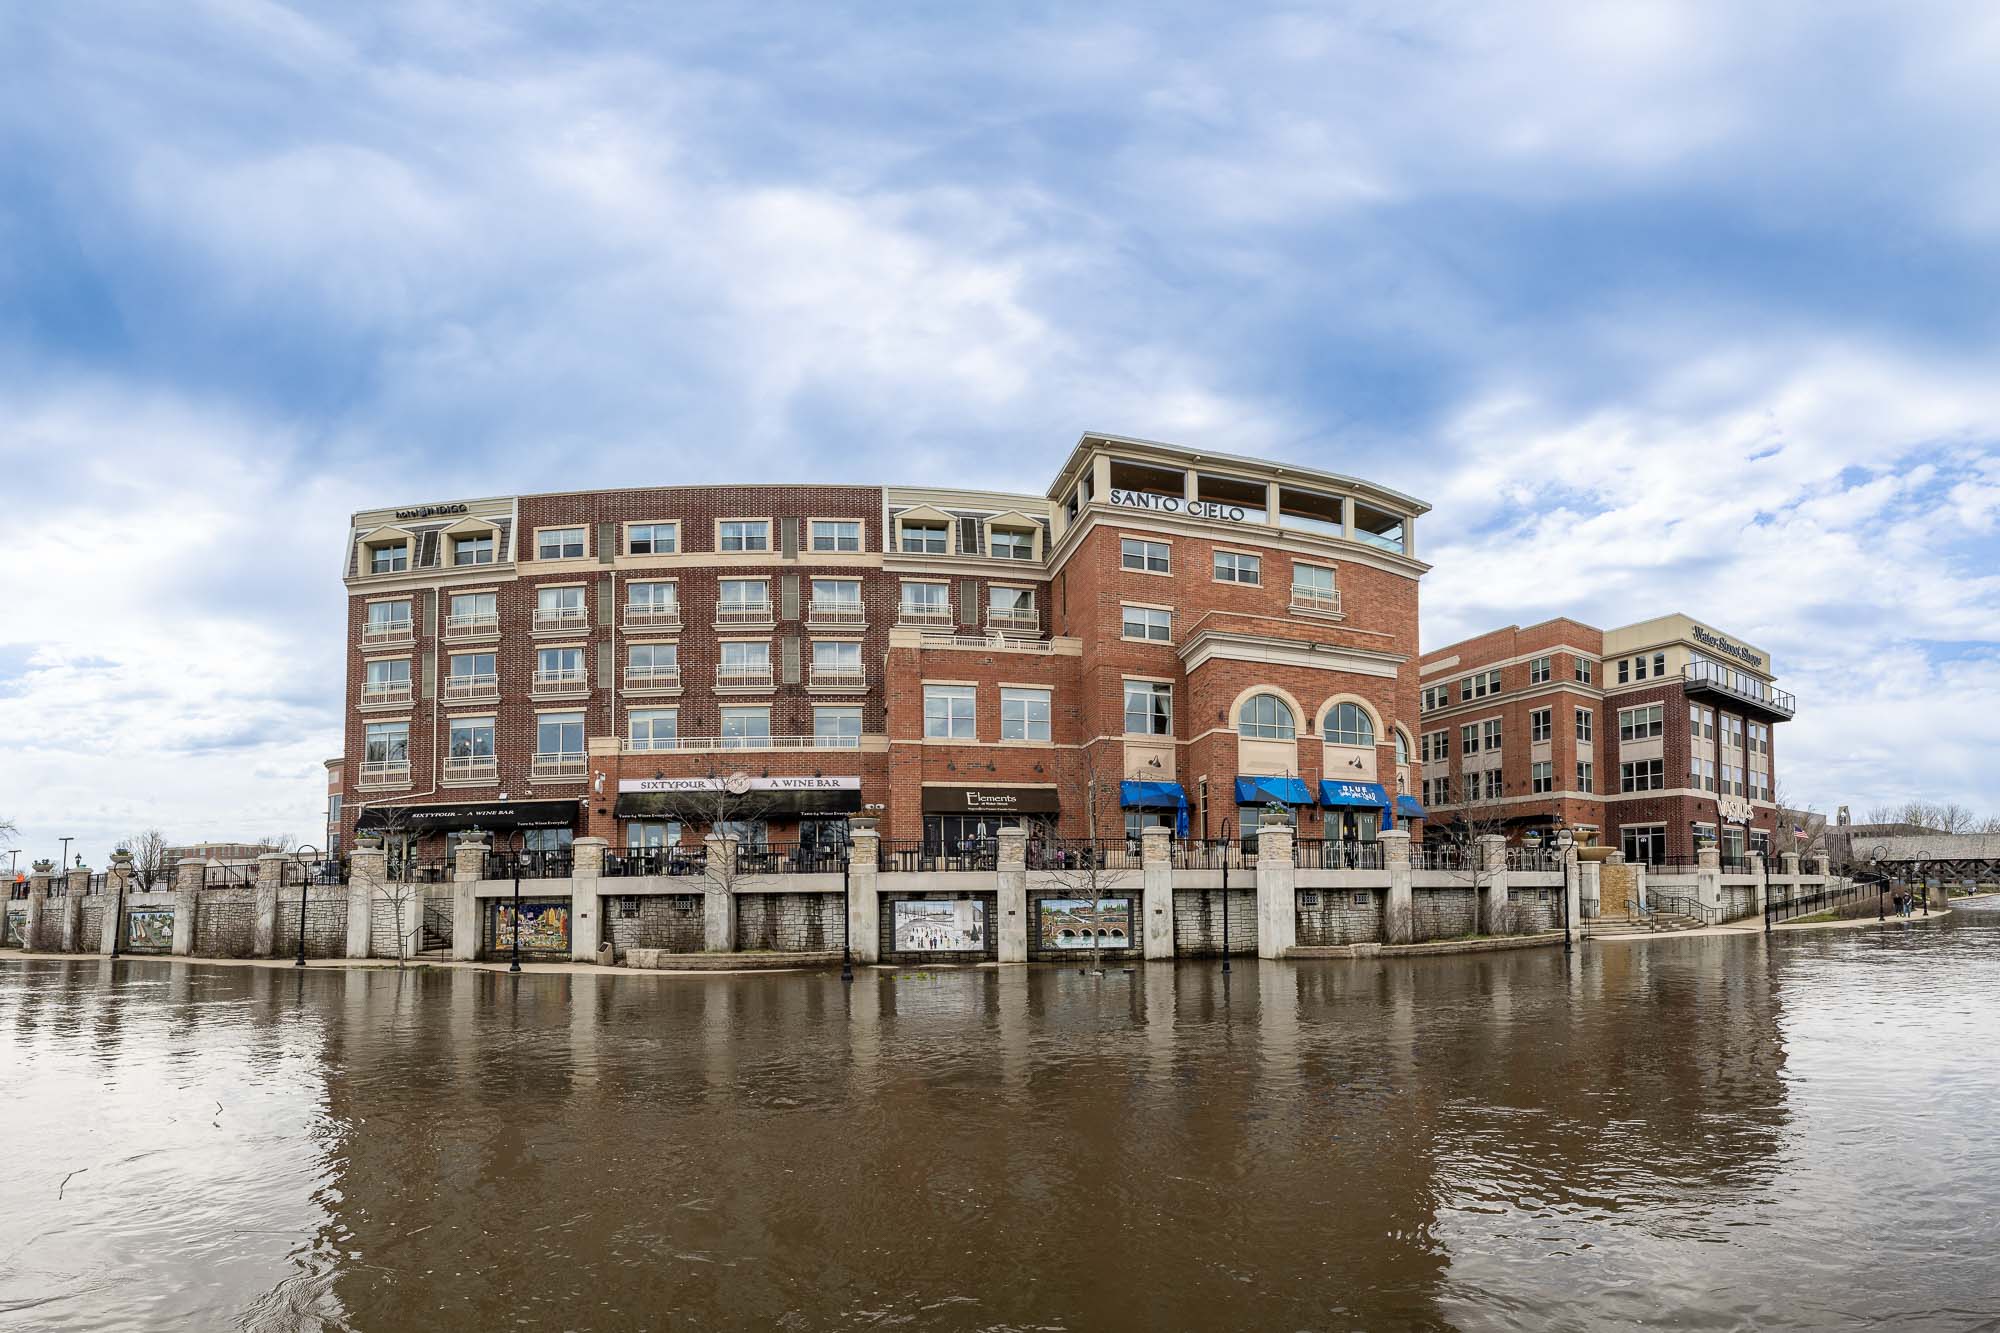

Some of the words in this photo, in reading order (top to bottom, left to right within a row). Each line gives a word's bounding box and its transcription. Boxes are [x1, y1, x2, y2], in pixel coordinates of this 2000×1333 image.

[1110, 490, 1179, 512] SANTO
[1187, 501, 1244, 521] CIELO
[1693, 626, 1719, 646] Water
[1718, 638, 1741, 658] Street
[640, 781, 706, 790] SIXTYFOUR
[782, 780, 814, 788] WINE
[966, 792, 1016, 806] Elements
